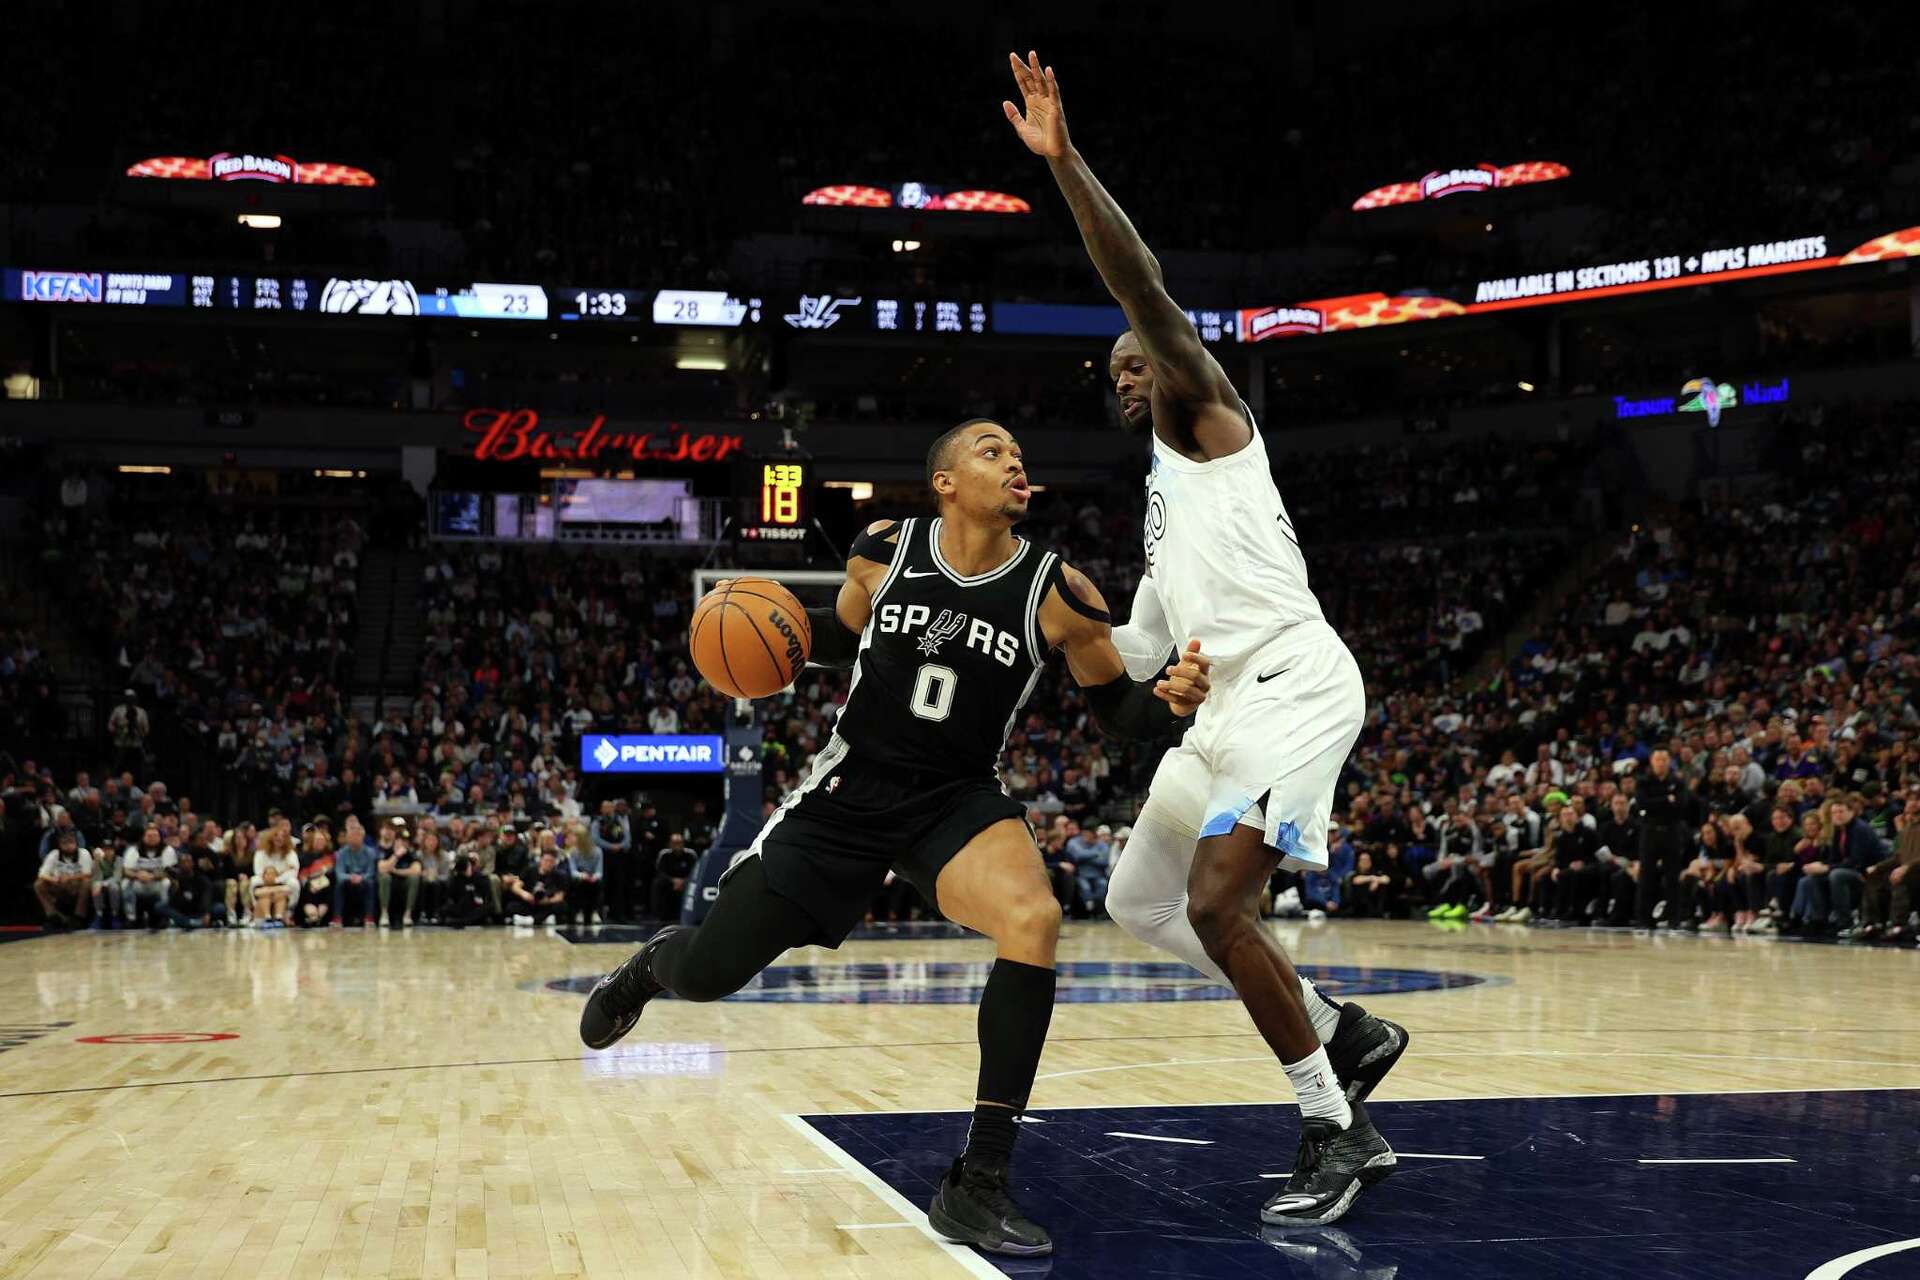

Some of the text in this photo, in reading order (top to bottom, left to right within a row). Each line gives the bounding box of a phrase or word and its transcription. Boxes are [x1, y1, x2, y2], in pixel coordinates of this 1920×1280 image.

[214, 155, 291, 179] RED BARON
[1475, 272, 1554, 303] AVAILABLE
[1555, 270, 1575, 292] IN
[1576, 260, 1650, 290] SECTIONS
[1653, 256, 1681, 279] 131
[1701, 247, 1746, 274] MPLS
[1748, 235, 1827, 267] MARKETS
[22, 271, 102, 302] KFAN
[503, 295, 529, 313] 23
[575, 291, 626, 316] 1:33
[673, 300, 698, 320] 28
[763, 486, 798, 523] 18
[759, 528, 807, 540] TISSOT
[880, 604, 1020, 668] SPURS
[909, 662, 959, 722] 0
[621, 745, 712, 763] PENTAIR
